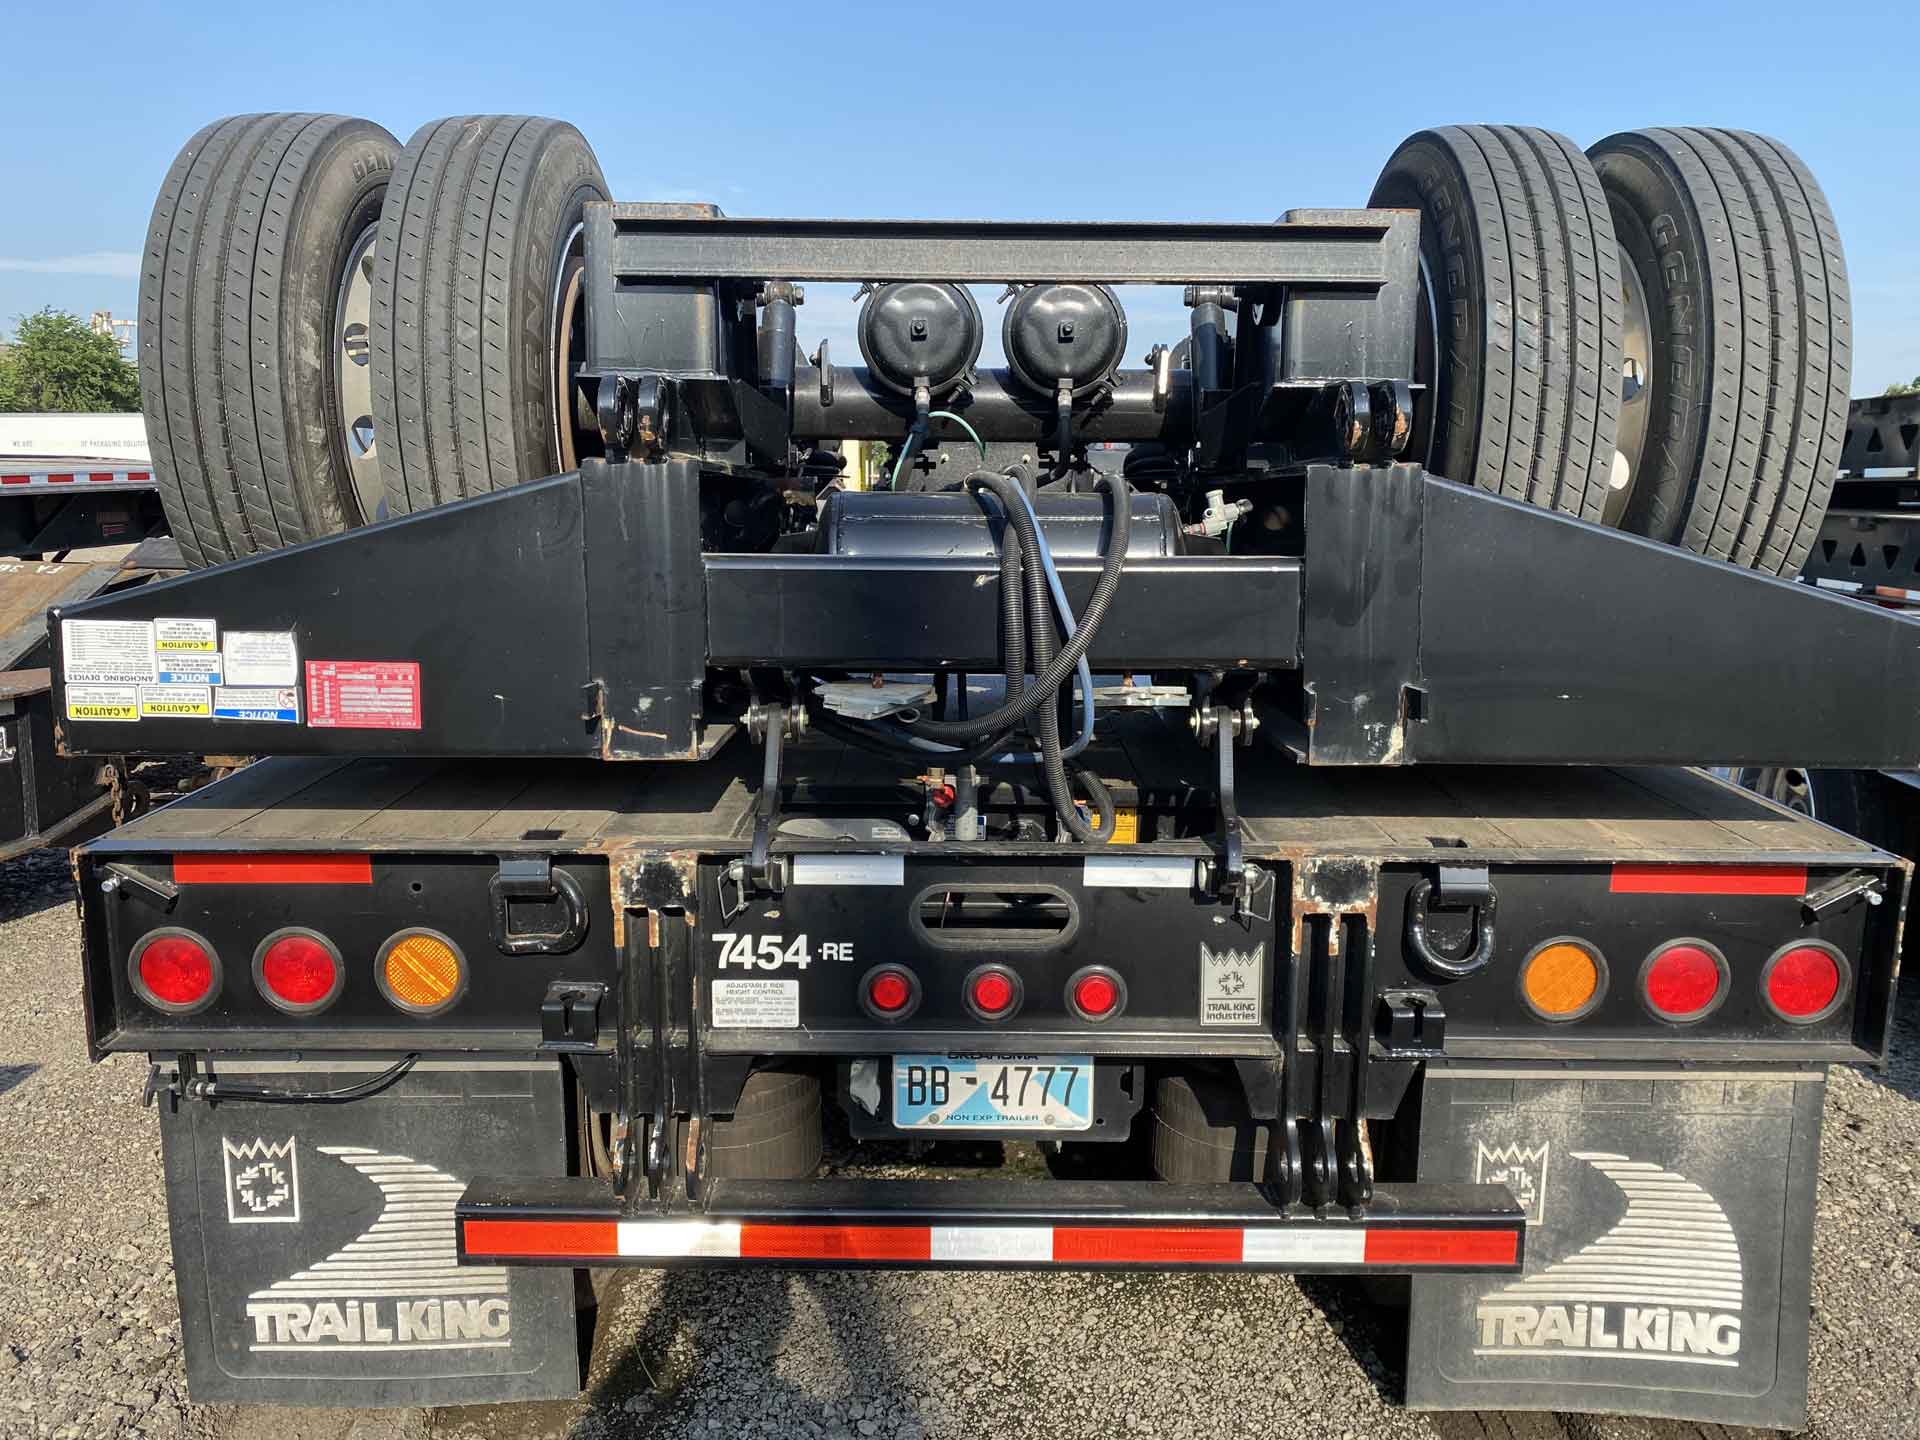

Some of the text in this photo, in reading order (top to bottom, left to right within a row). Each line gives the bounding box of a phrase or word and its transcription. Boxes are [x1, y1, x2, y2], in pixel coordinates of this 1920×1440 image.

[105, 675, 154, 683] ANCHORING
[170, 673, 209, 681] NOTICE
[75, 707, 120, 716] CAUTION
[151, 704, 191, 712] CAUTION
[239, 711, 278, 720] NOTICE
[712, 933, 812, 970] 7454
[907, 1066, 1080, 1107] BB 4777
